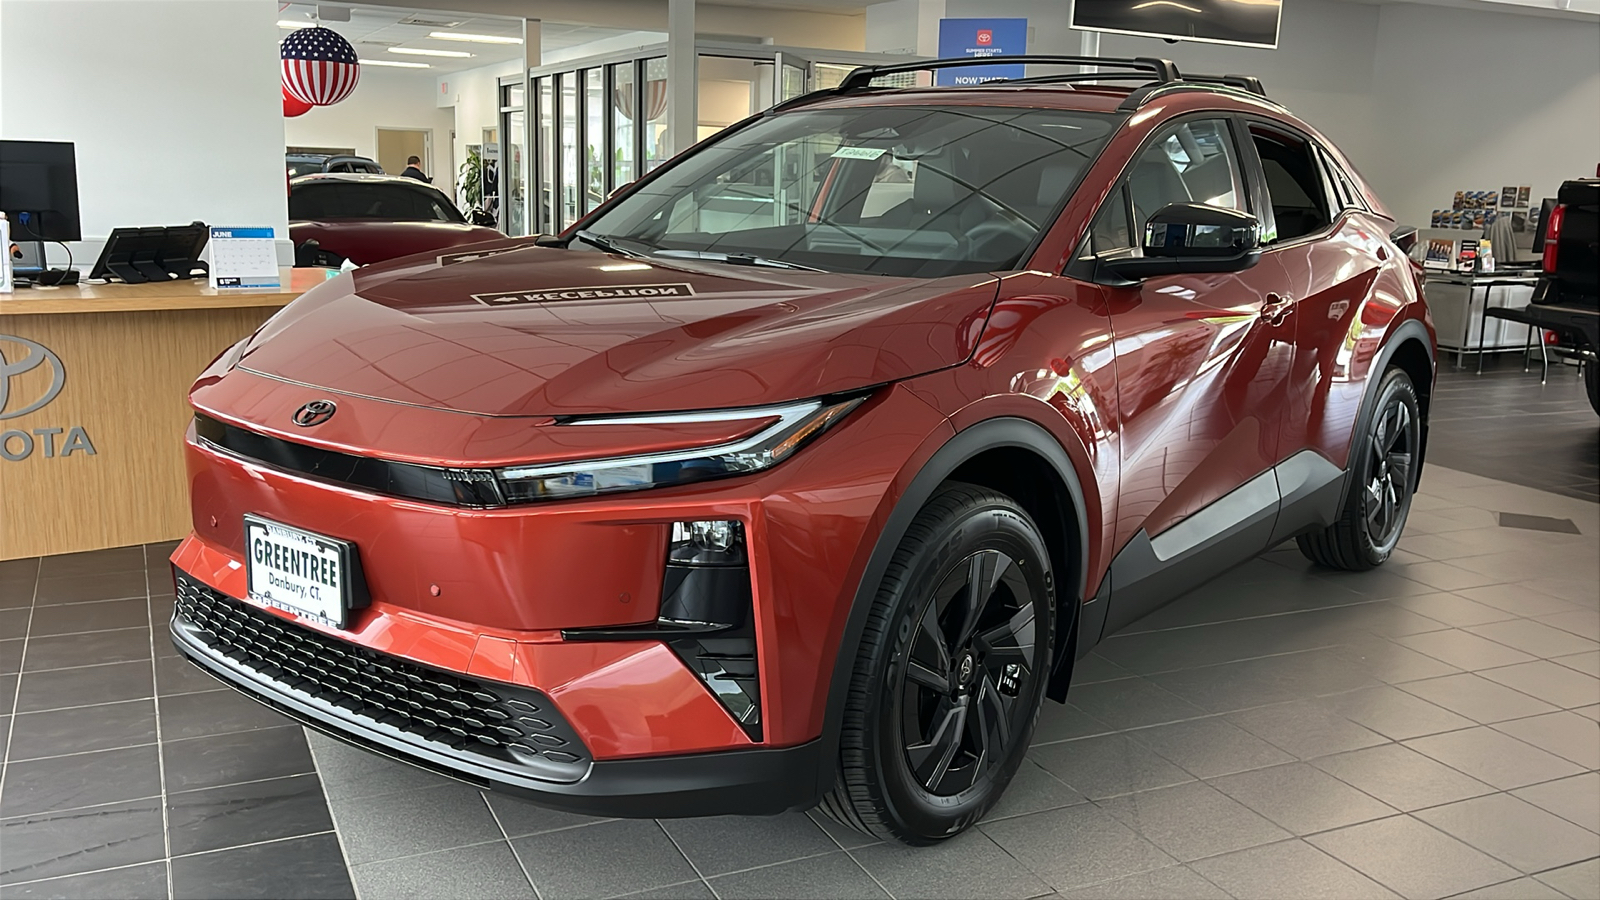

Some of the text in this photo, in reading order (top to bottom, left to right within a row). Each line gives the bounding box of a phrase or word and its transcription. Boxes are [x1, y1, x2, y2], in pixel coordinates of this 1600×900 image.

[254, 537, 337, 588] GREENTREE
[269, 572, 322, 601] Danbury, CT.
